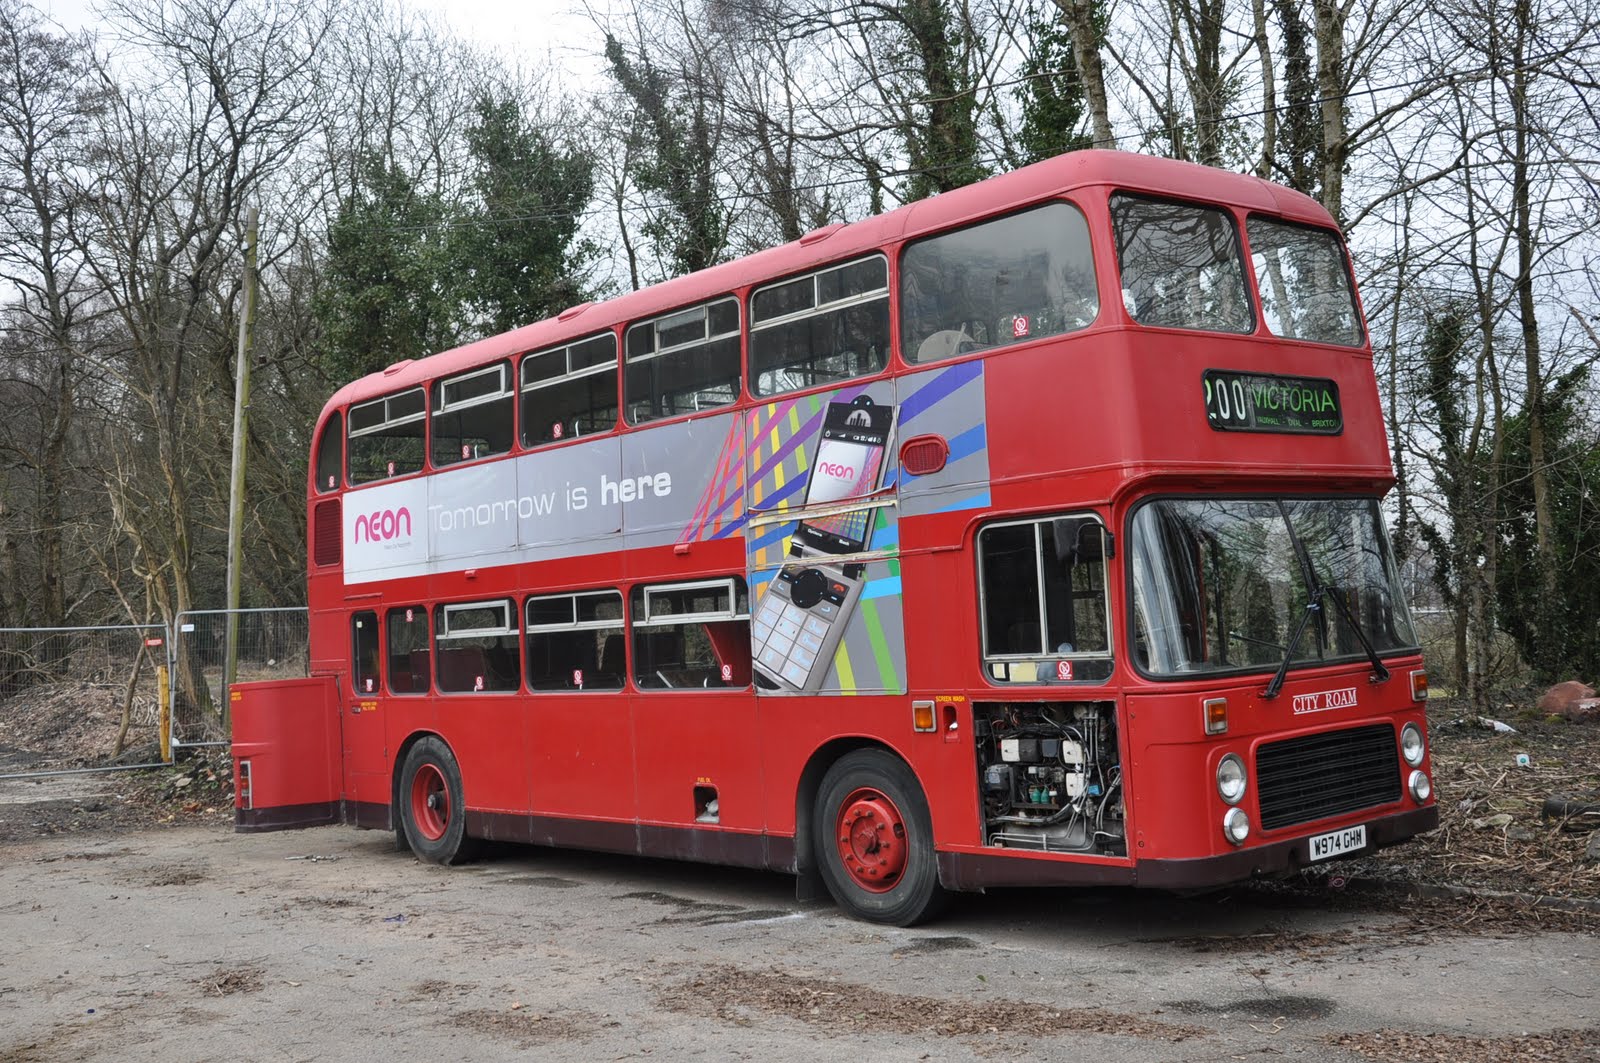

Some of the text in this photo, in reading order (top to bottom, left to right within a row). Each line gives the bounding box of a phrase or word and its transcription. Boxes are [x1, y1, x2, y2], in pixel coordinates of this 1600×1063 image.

[1251, 384, 1337, 412] VICTORIA
[1311, 420, 1338, 428] BRIXTO
[428, 471, 672, 534] Tomorrow is here
[1292, 689, 1357, 713] CITY ROAM
[1314, 834, 1341, 856] W974
